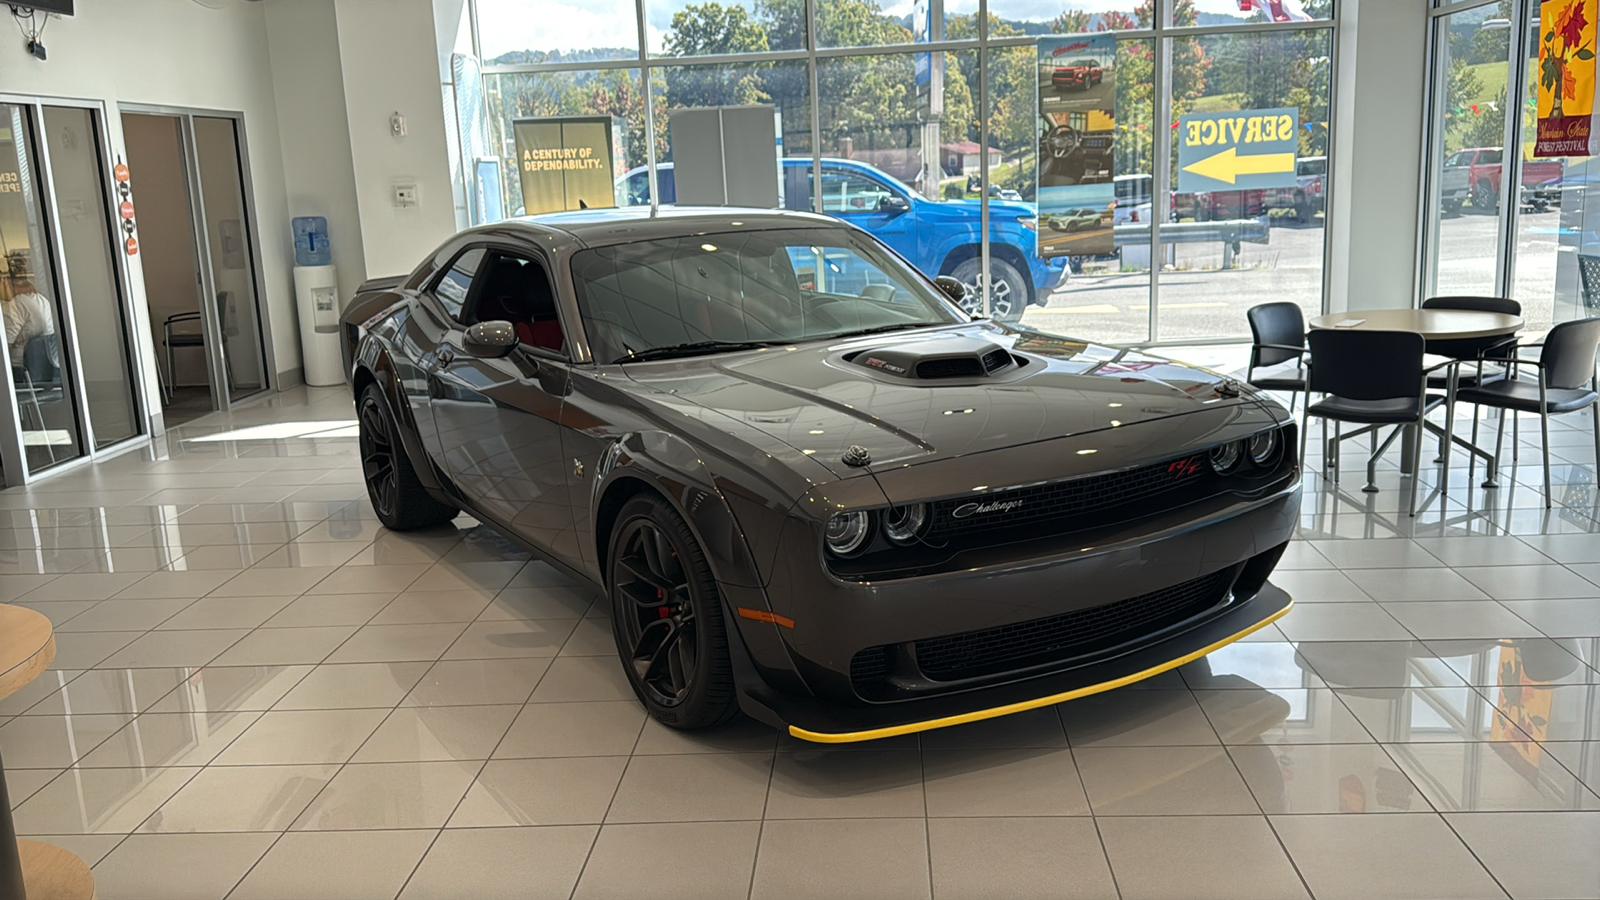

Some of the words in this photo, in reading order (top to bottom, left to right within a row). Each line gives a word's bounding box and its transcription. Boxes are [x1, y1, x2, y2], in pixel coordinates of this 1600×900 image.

[1555, 139, 1586, 152] FESTIVAL
[524, 149, 531, 160] A
[532, 148, 577, 160] CENTURY
[579, 147, 592, 158] OF
[524, 158, 603, 171] DEPENDABILITY.
[1167, 456, 1200, 480] R/T
[952, 500, 1023, 518] Challenger
